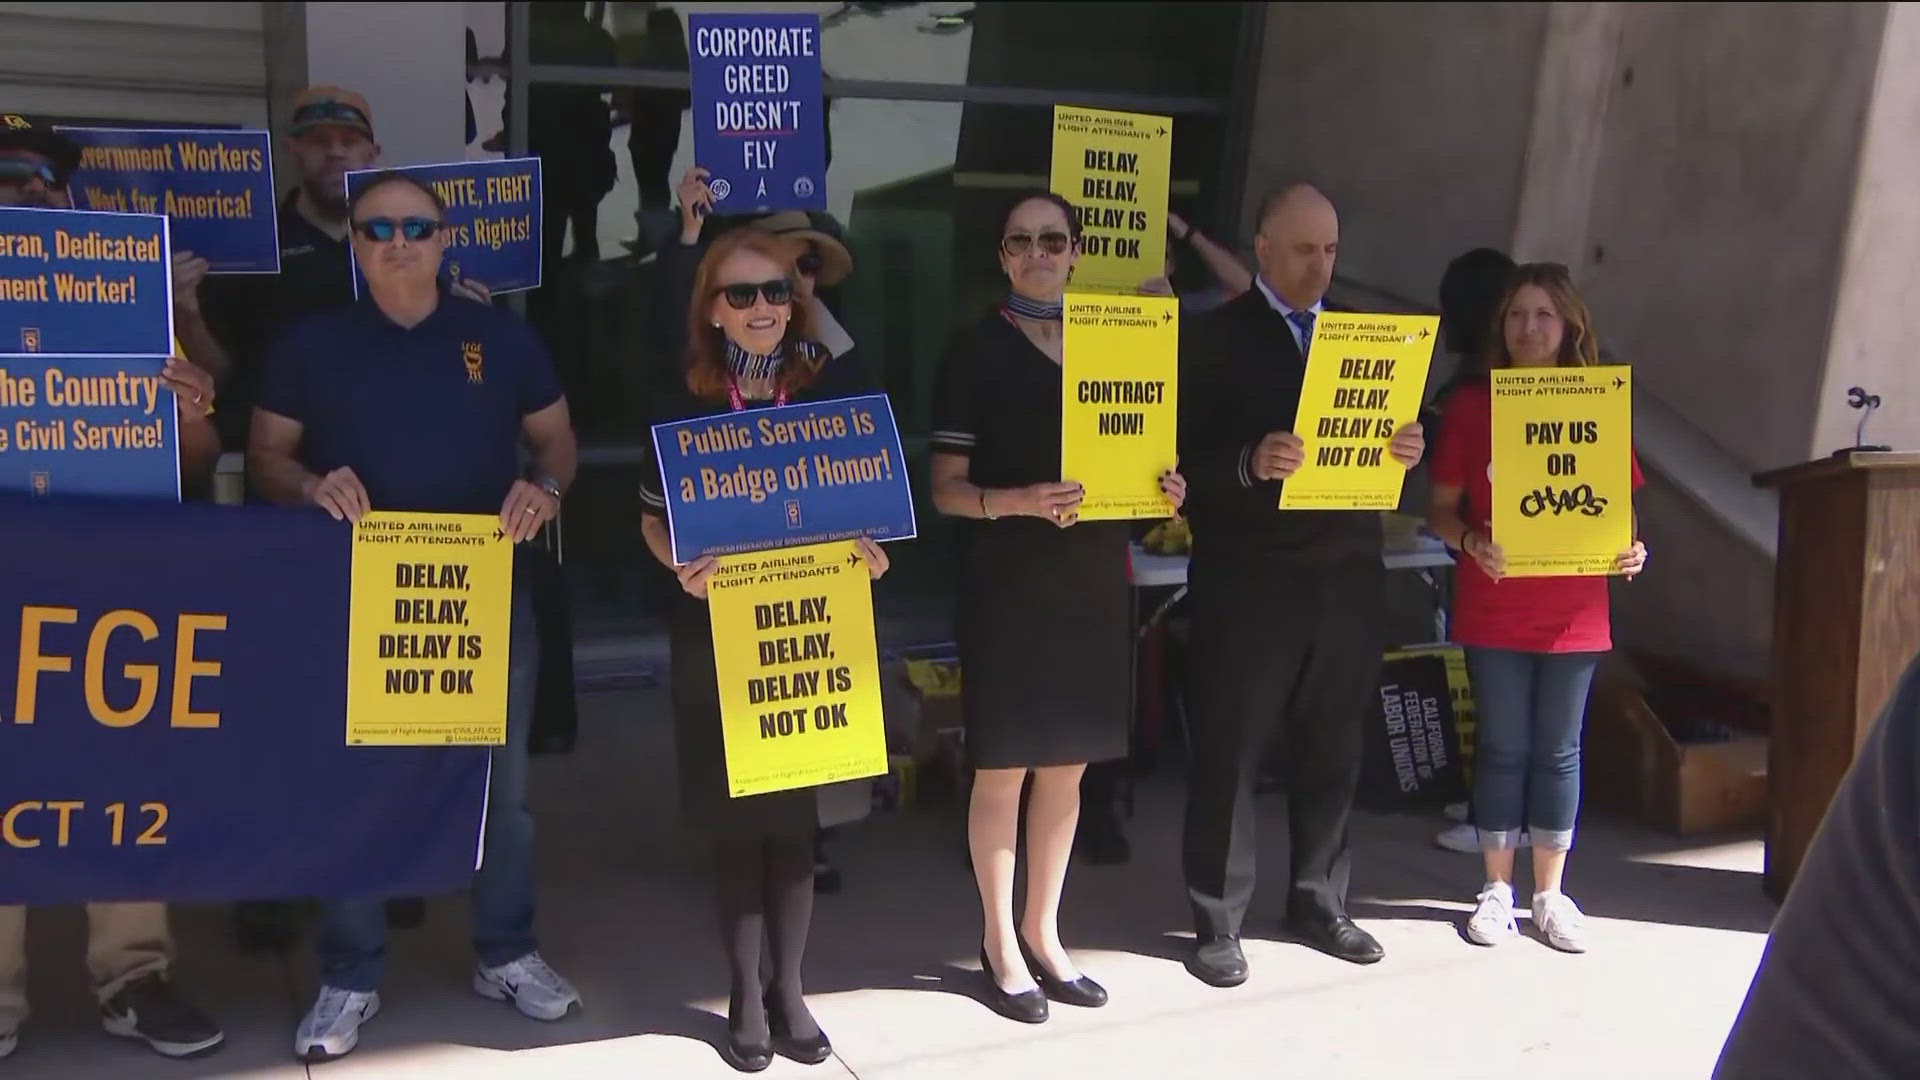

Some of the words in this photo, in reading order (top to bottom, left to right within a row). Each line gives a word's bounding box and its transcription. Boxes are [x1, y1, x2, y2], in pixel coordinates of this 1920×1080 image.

[697, 27, 814, 57] CORPORATE
[724, 64, 790, 94] GREED
[716, 101, 801, 130] DOESN'T
[1058, 112, 1092, 123] UNITED
[1094, 116, 1134, 127] AIRLINES
[1057, 123, 1088, 133] FLIGHT
[1091, 127, 1151, 140] ATTENDANTS
[177, 141, 262, 172] Workers
[743, 140, 777, 170] FLY
[1084, 149, 1139, 176] DELAY,
[131, 186, 157, 213] for
[164, 187, 252, 219] America!
[432, 178, 482, 210] NITE,
[486, 174, 531, 205] FIGHT
[1083, 177, 1137, 204] DELAY,
[474, 214, 530, 250] Rights!
[1072, 205, 1125, 230] DELAY
[1128, 210, 1147, 231] IS
[55, 229, 160, 263] Dedicated
[1115, 237, 1140, 259] OK
[53, 272, 136, 304] Worker!
[1069, 304, 1102, 314] UNITED
[1104, 306, 1142, 315] AIRLINES
[1069, 317, 1099, 326] FLIGHT
[1102, 318, 1158, 328] ATTENDANTS
[1318, 333, 1351, 342] FLIGHT
[1353, 334, 1413, 344] ATTENDANT
[1321, 322, 1354, 332] UNITED
[1356, 323, 1397, 332] AIRLINES
[1339, 358, 1396, 382] DELAY,
[1496, 376, 1535, 385] UNITED
[1538, 375, 1585, 384] AIRLINES
[44, 368, 158, 415] Country
[1077, 380, 1164, 404] CONTRACT
[1333, 387, 1389, 411] DELAY,
[1496, 387, 1532, 397] FLIGHT
[1535, 386, 1606, 396] ATTENDANTS
[15, 419, 65, 450] Civil
[72, 418, 163, 449] Service!
[677, 423, 753, 457] Public
[757, 412, 847, 446] Service
[850, 407, 875, 436] is
[1099, 413, 1144, 436] NOW!
[1316, 417, 1373, 439] DELAY
[1375, 418, 1394, 439] IS
[1525, 422, 1563, 445] PAY
[1569, 421, 1598, 444] US
[1316, 447, 1355, 467] NOT
[1357, 447, 1383, 467] OK
[1547, 453, 1576, 476] OR
[680, 476, 696, 504] a
[700, 464, 779, 504] Badge
[784, 456, 809, 491] of
[813, 448, 893, 487] Honor!
[1520, 484, 1608, 518] CHAOS
[358, 534, 400, 543] FLIGHT
[404, 535, 485, 545] ATTENDANTS
[359, 521, 404, 531] UNITED
[408, 522, 462, 532] AIRLINES
[761, 555, 815, 569] AIRLINES
[396, 563, 470, 591] DELAY,
[713, 576, 755, 590] FLIGHT
[759, 565, 840, 584] ATTENDANTS
[394, 599, 469, 627] DELAY,
[754, 596, 831, 630] DELAY,
[379, 634, 452, 659] DELAY
[457, 635, 482, 660] IS
[758, 632, 835, 667] DELAY,
[0, 605, 227, 728] FGE
[385, 669, 434, 694] NOT
[440, 669, 474, 694] OK
[747, 670, 820, 704] DELAY
[827, 666, 852, 694] IS
[759, 709, 807, 739] NOT
[814, 703, 849, 731] OK
[1380, 684, 1406, 736] LABOR
[1403, 690, 1429, 764] FEDERATION
[1421, 696, 1448, 769] CALIFORNIA
[1389, 736, 1420, 793] UNIONS
[104, 802, 169, 846] 12
